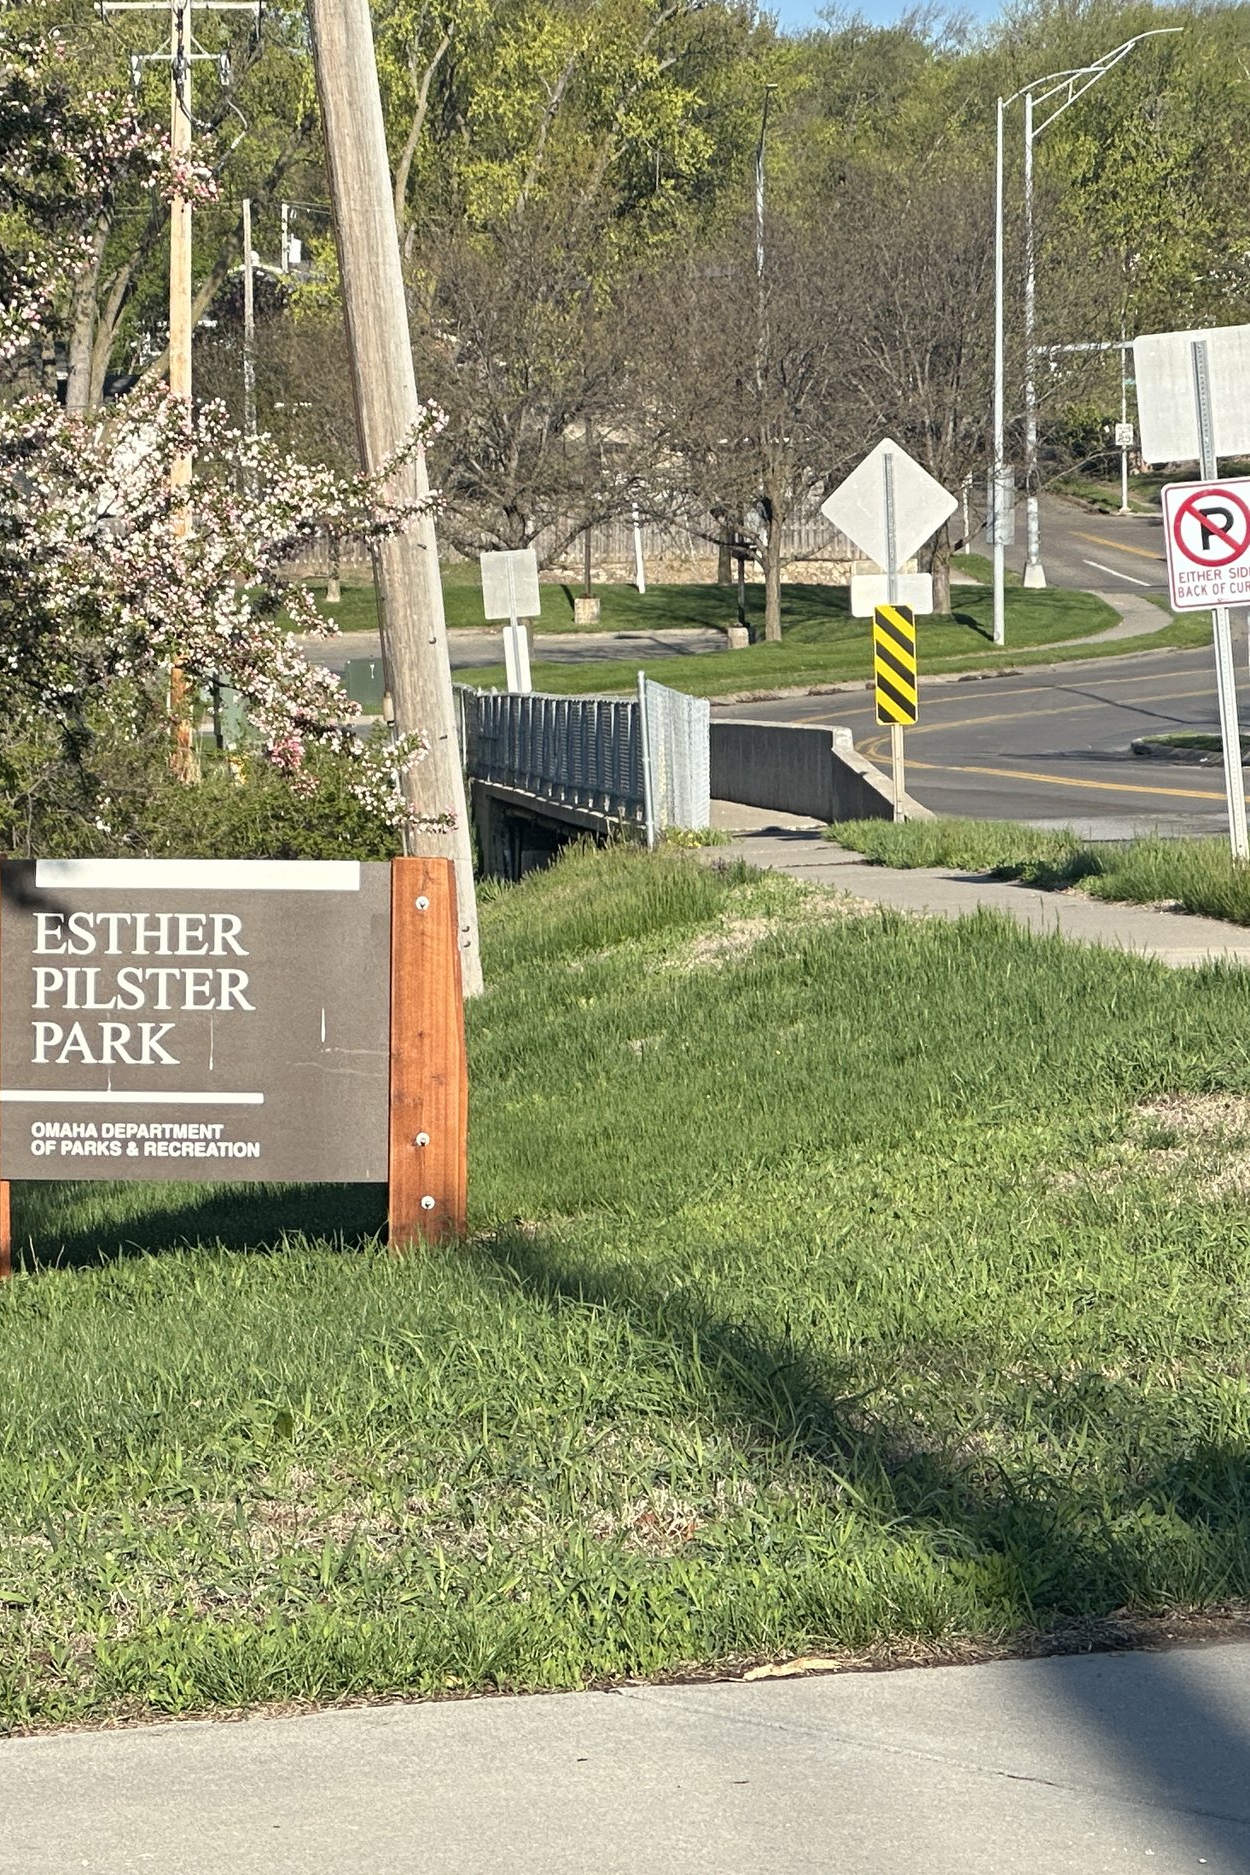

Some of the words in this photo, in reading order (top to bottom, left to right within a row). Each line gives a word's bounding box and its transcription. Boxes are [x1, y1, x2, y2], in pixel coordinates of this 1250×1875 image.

[1178, 569, 1222, 583] EITHER
[1229, 567, 1250, 579] SID
[1178, 584, 1208, 598] BACK
[1212, 582, 1226, 595] OF
[31, 912, 250, 956] ESTHER
[31, 966, 257, 1011] PILSTER
[30, 1021, 181, 1065] PARK
[31, 1121, 98, 1139] OMAHA
[101, 1122, 225, 1140] DEPARTMENT
[31, 1139, 57, 1156] OF
[60, 1139, 123, 1157] PARKS
[125, 1140, 140, 1157] &
[143, 1141, 261, 1158] RECREATION
